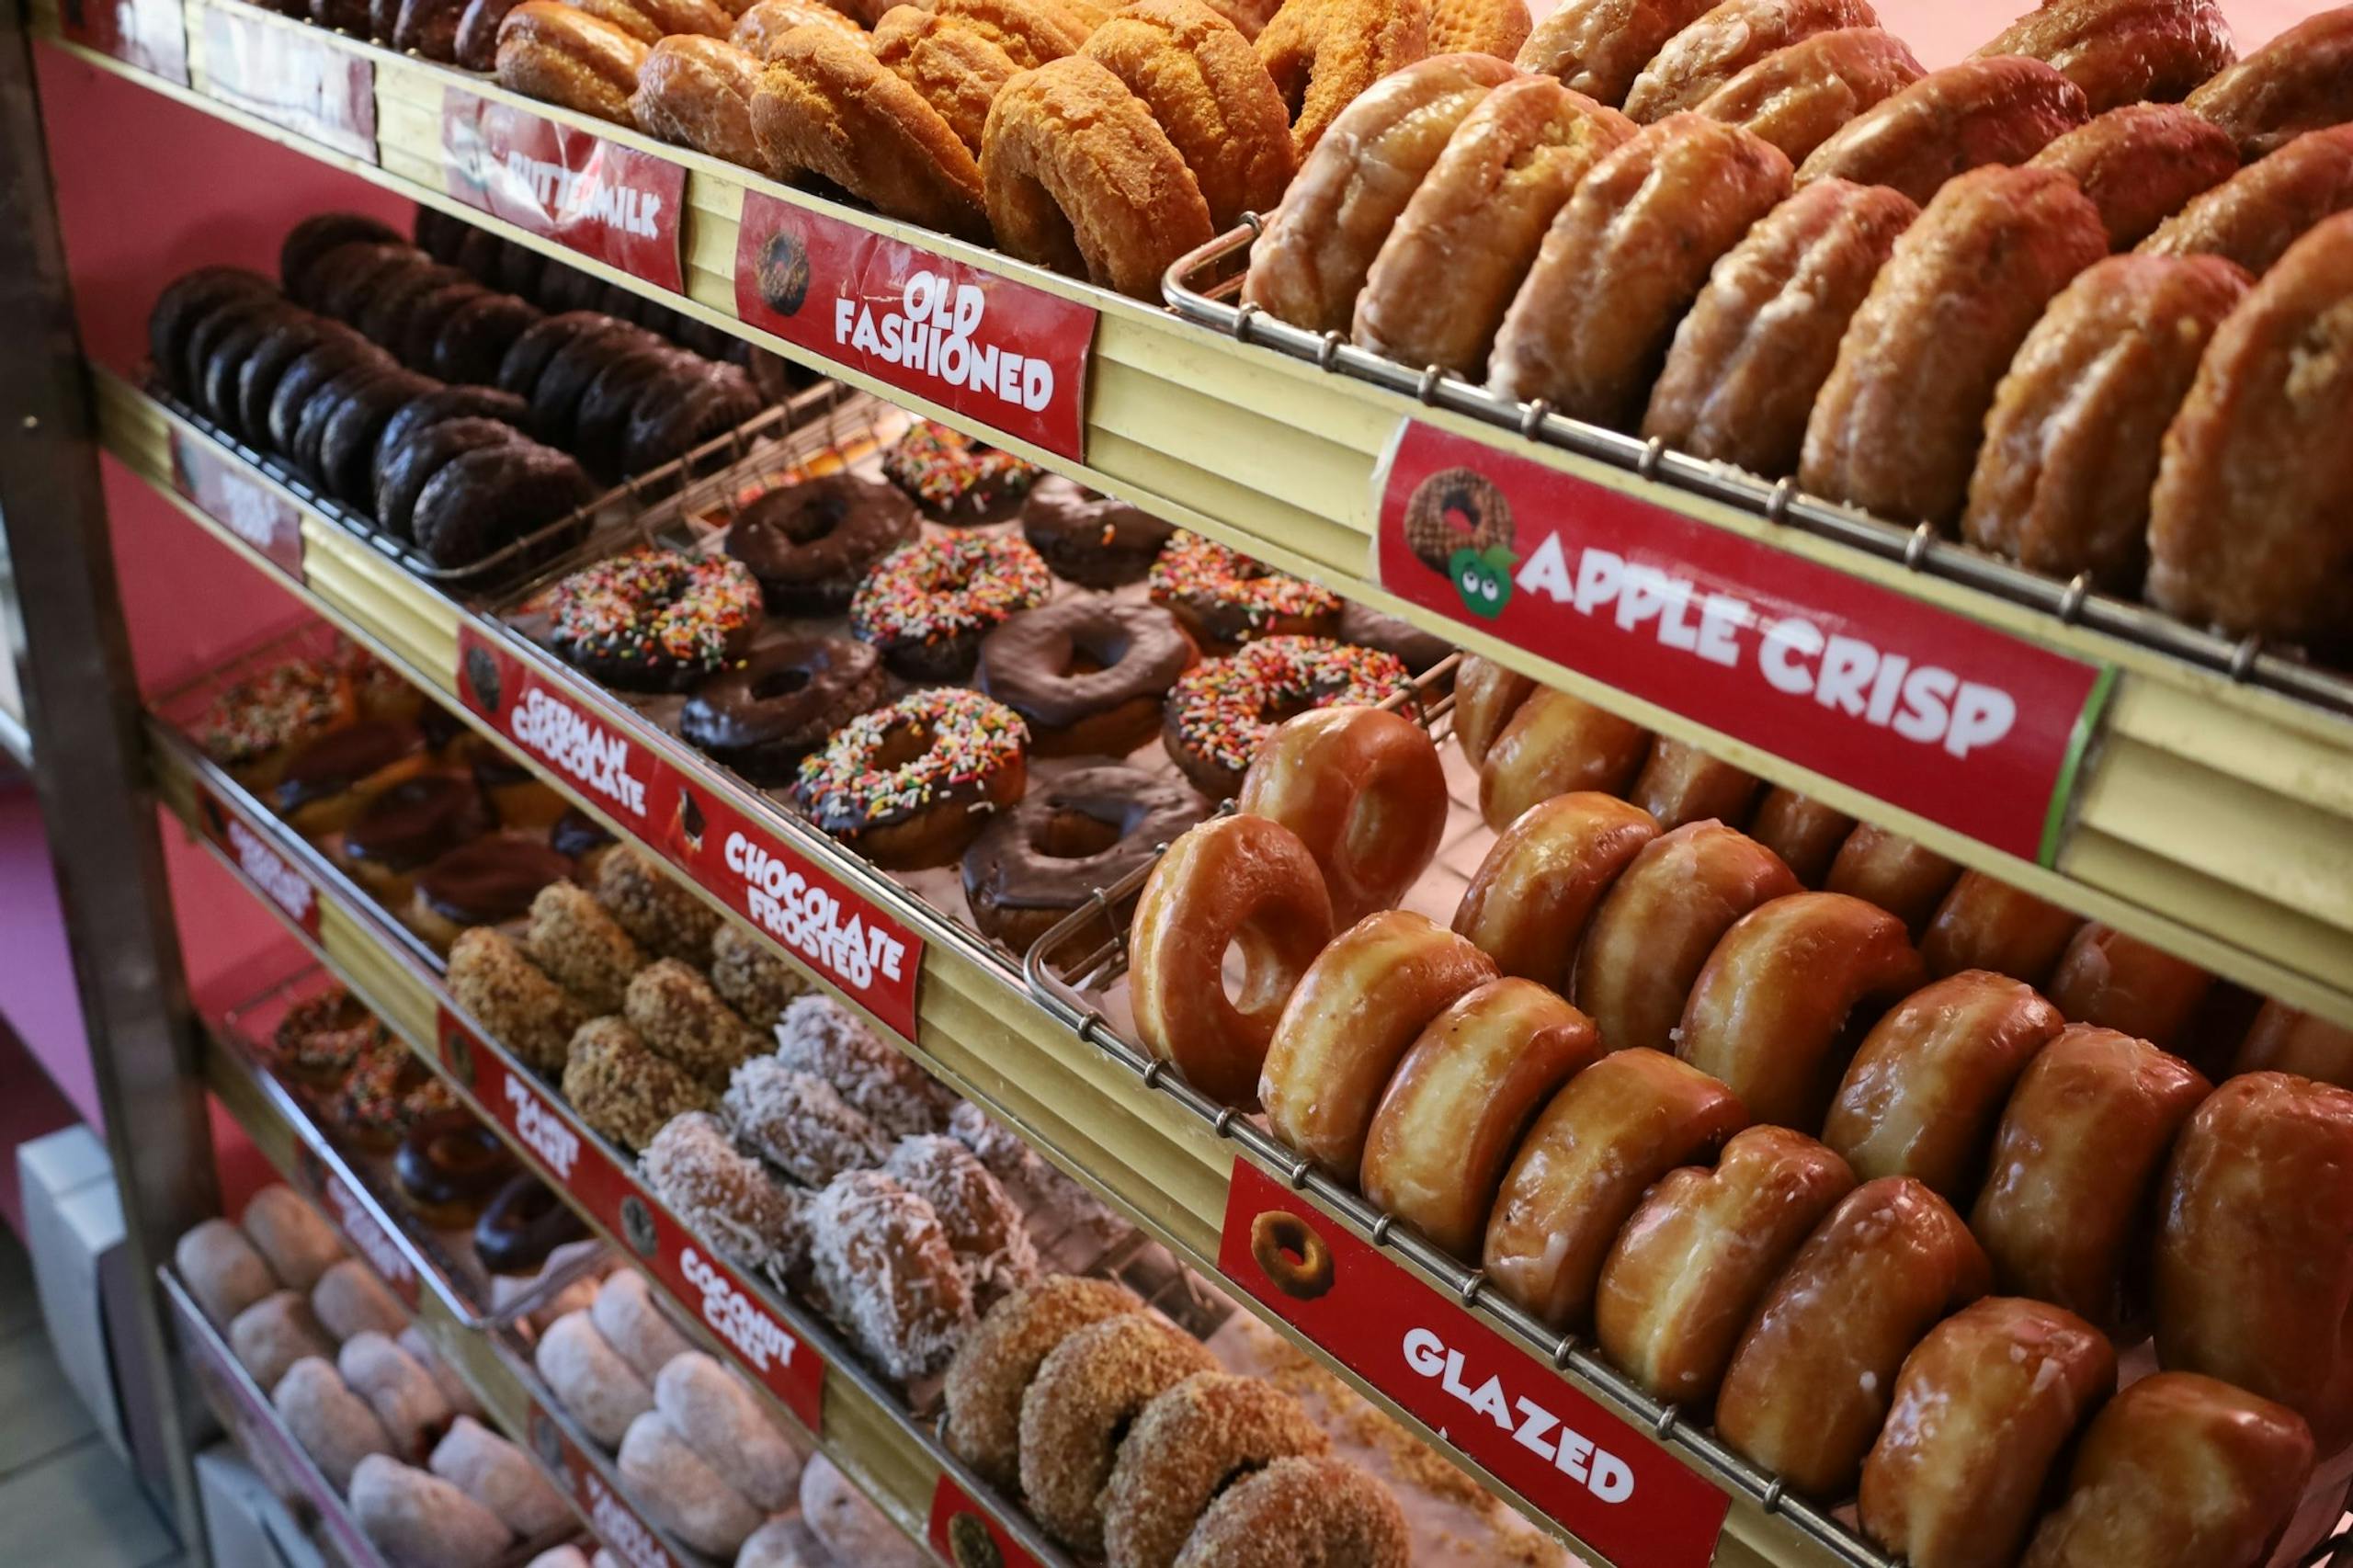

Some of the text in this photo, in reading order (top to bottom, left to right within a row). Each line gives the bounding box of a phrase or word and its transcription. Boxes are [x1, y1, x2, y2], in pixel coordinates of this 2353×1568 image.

[835, 298, 1053, 412] FASHIONED
[904, 270, 984, 336] OLD
[1516, 530, 2016, 760] APPLE CRISP
[511, 706, 646, 817] CHOCOLATE
[528, 687, 627, 774] GERMAN
[724, 831, 904, 983] CHOCOLATE
[747, 885, 872, 990] FROSTED
[680, 1247, 796, 1367] COCONUT
[1403, 1328, 1634, 1503] GLAZED
